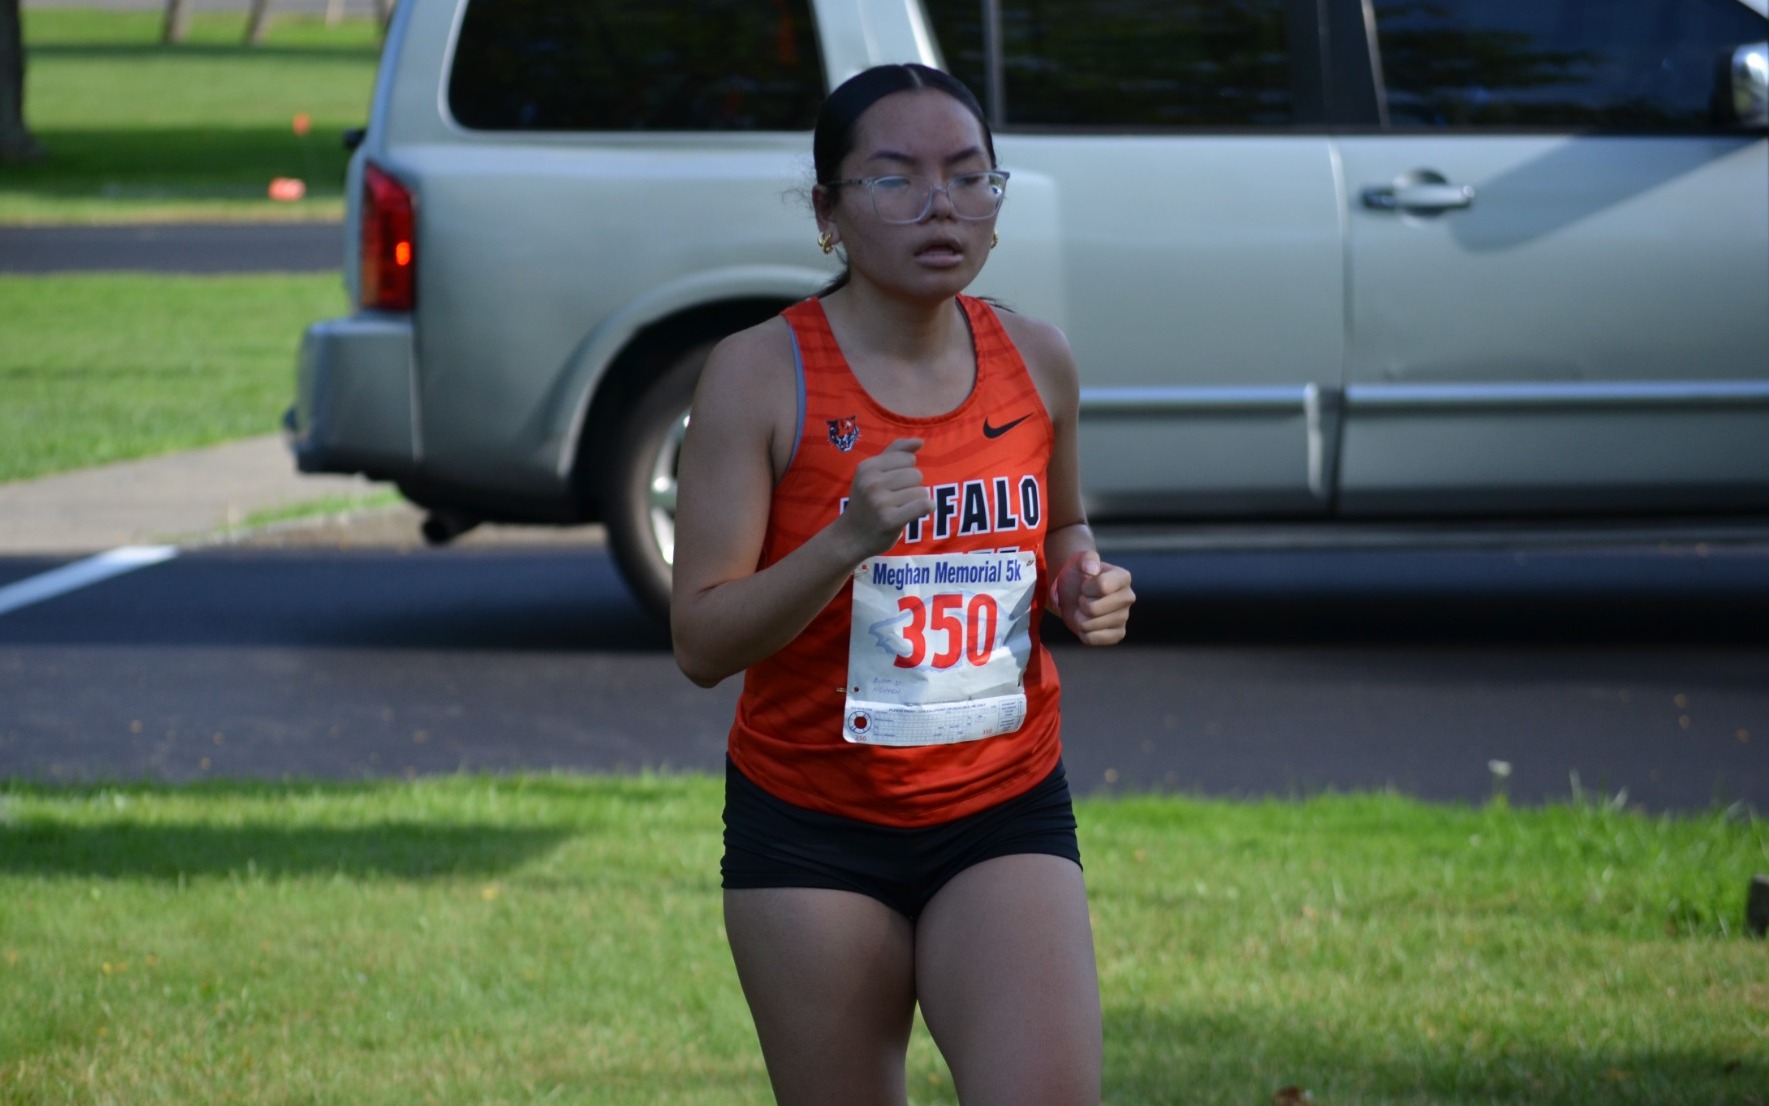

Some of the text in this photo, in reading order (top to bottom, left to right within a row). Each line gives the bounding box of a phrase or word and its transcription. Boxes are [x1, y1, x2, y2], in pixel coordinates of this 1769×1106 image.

[840, 475, 1041, 544] FALO
[873, 559, 1022, 590] Meghan Memorial 5k
[893, 593, 998, 669] 350
